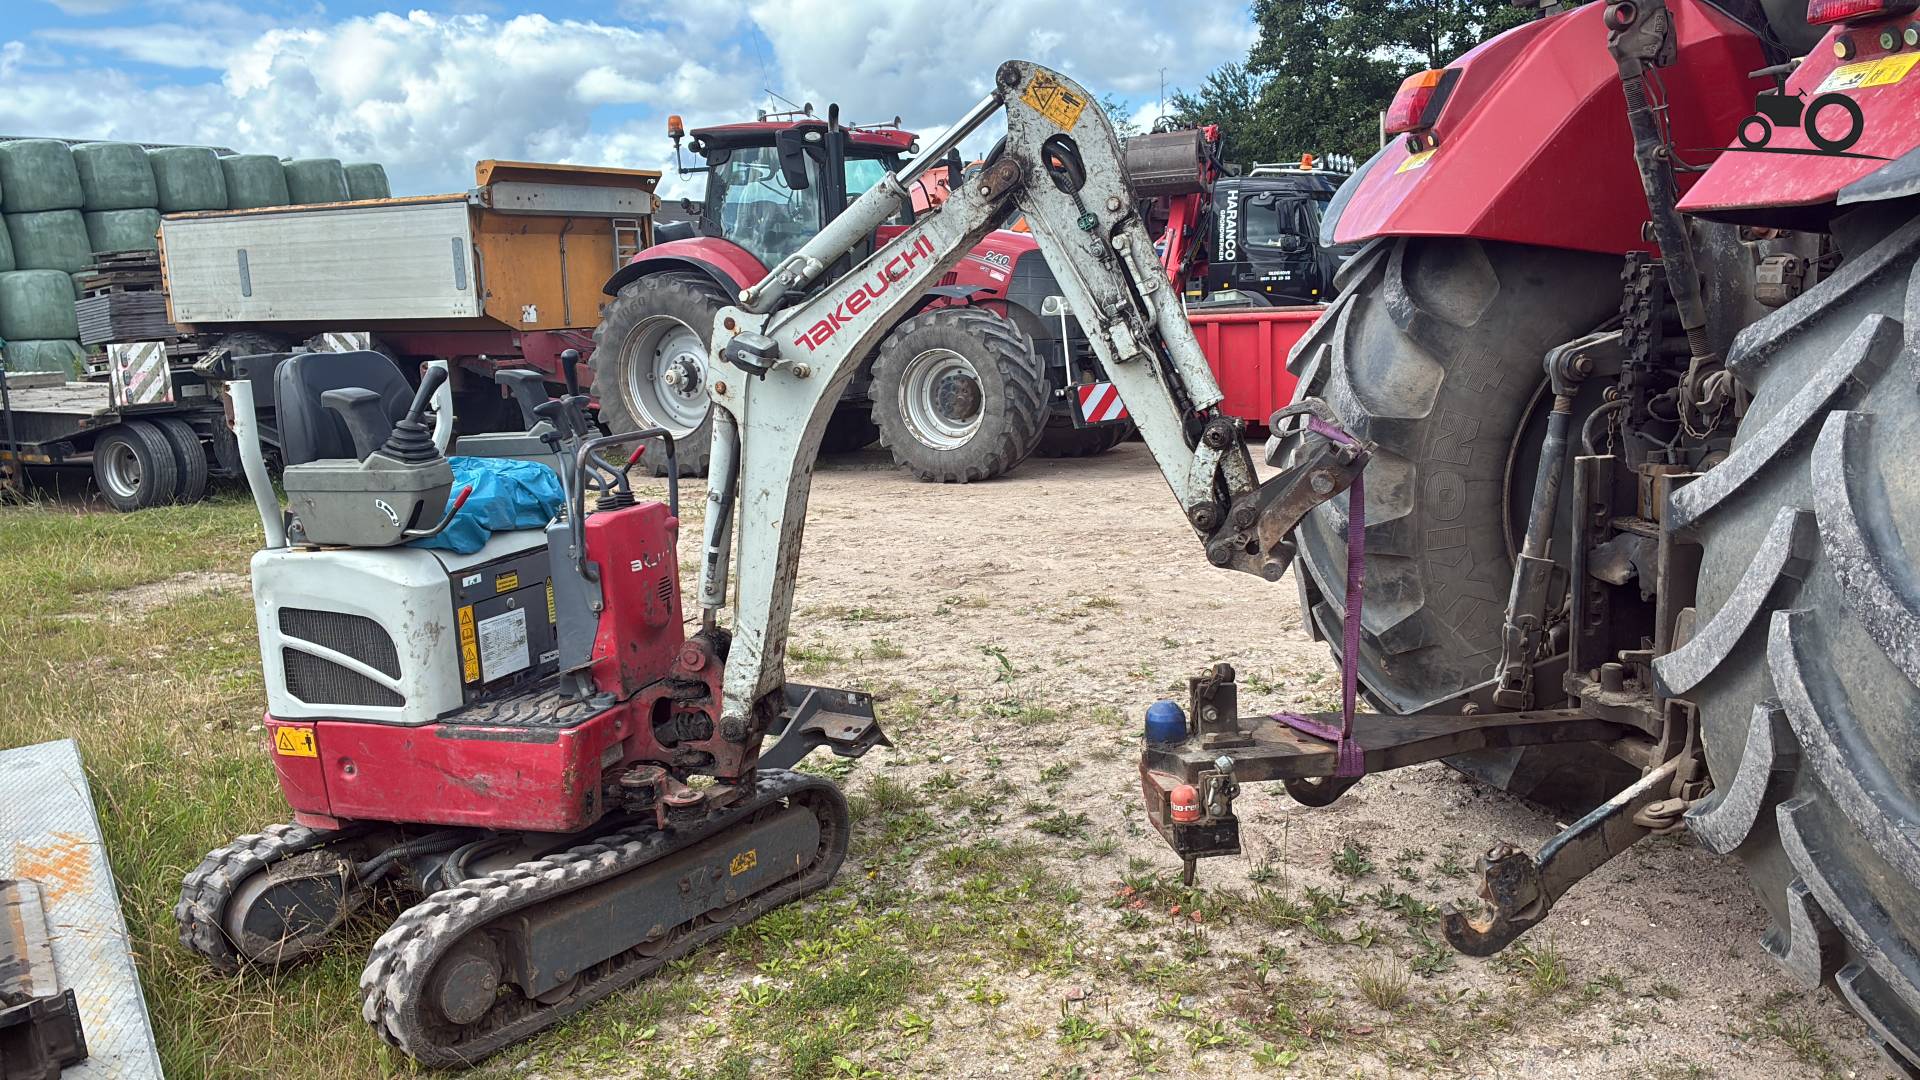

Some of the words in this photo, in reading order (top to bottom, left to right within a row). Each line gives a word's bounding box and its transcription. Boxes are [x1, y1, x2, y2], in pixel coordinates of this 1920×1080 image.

[983, 250, 1010, 267] 240
[1225, 190, 1238, 260] HARANCO
[794, 234, 936, 351] TAKEUCHI
